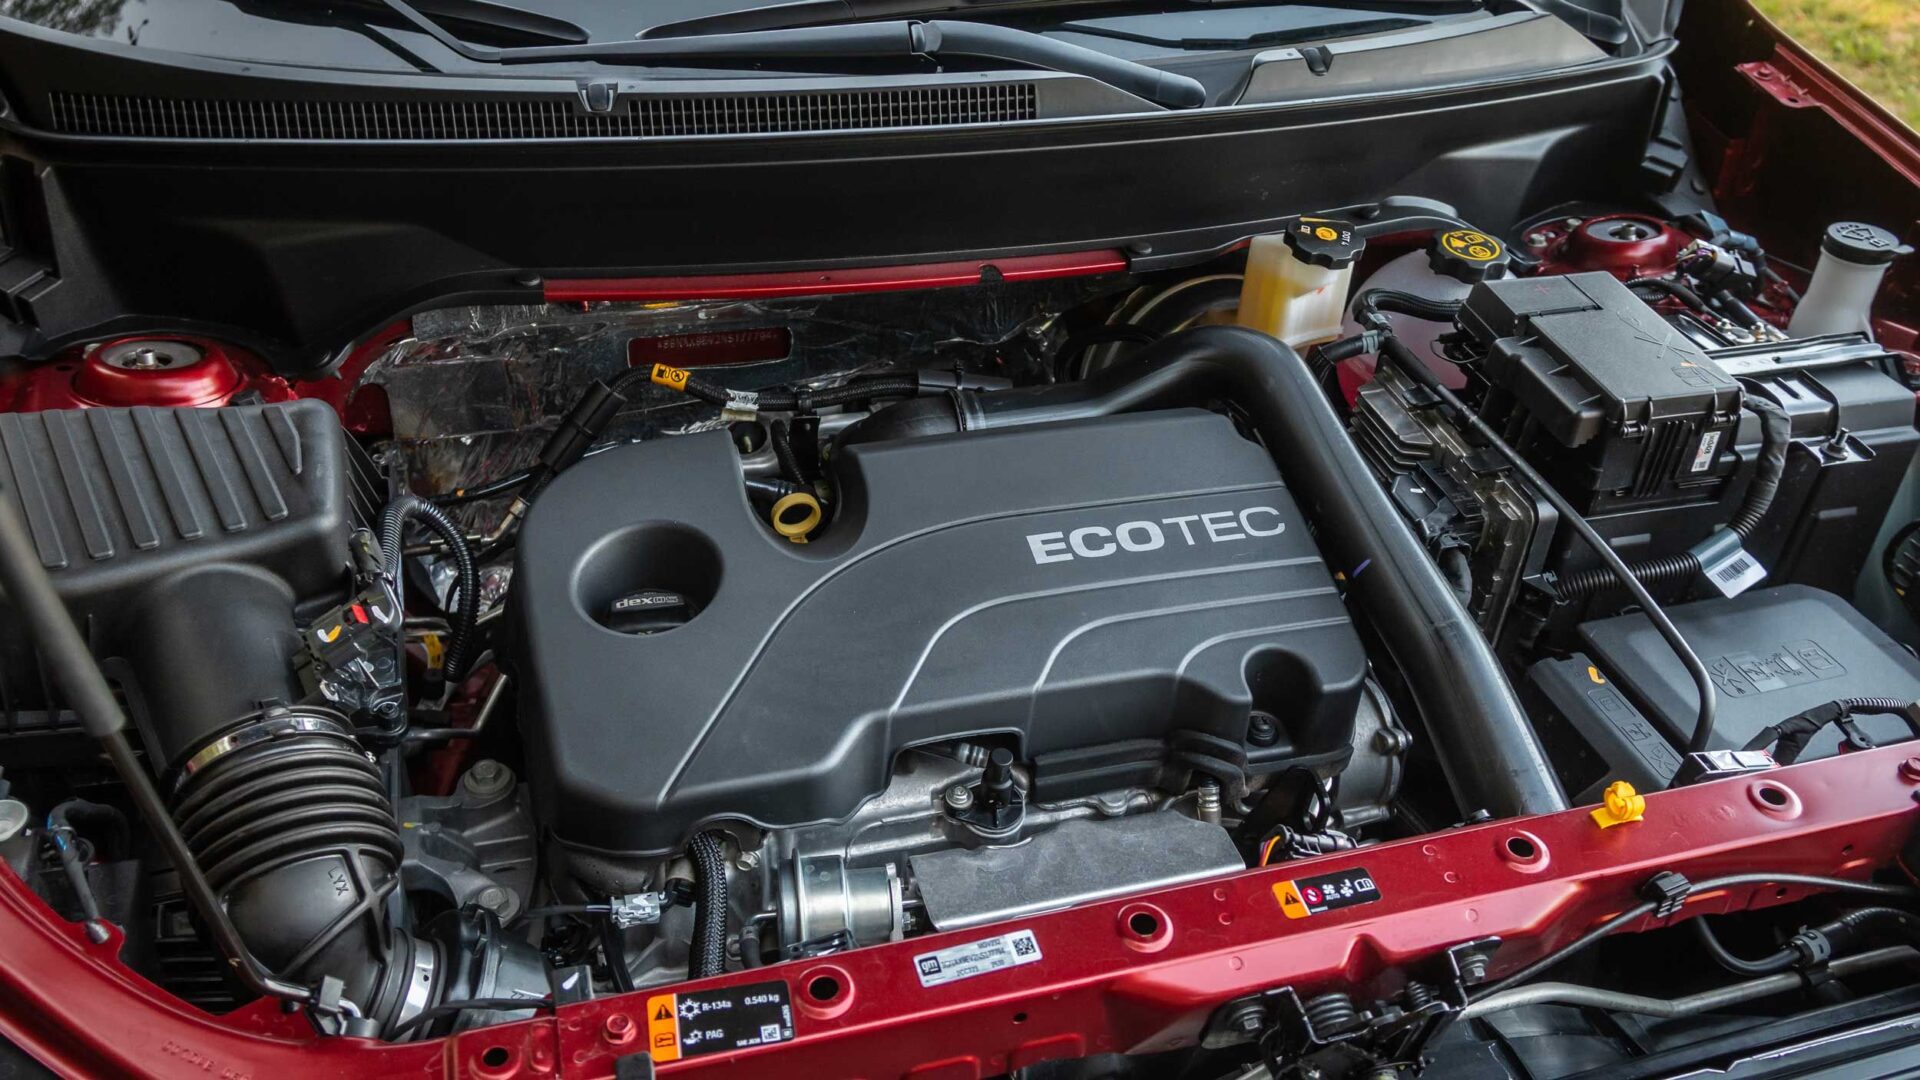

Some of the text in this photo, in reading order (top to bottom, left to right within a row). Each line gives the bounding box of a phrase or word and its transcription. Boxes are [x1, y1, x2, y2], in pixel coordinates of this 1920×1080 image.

[1342, 230, 1352, 242] DOT
[1025, 506, 1286, 565] ECOTEC
[920, 958, 938, 974] gm
[701, 993, 780, 1012] R-134a 0.540 kg
[705, 1029, 724, 1040] PAG
